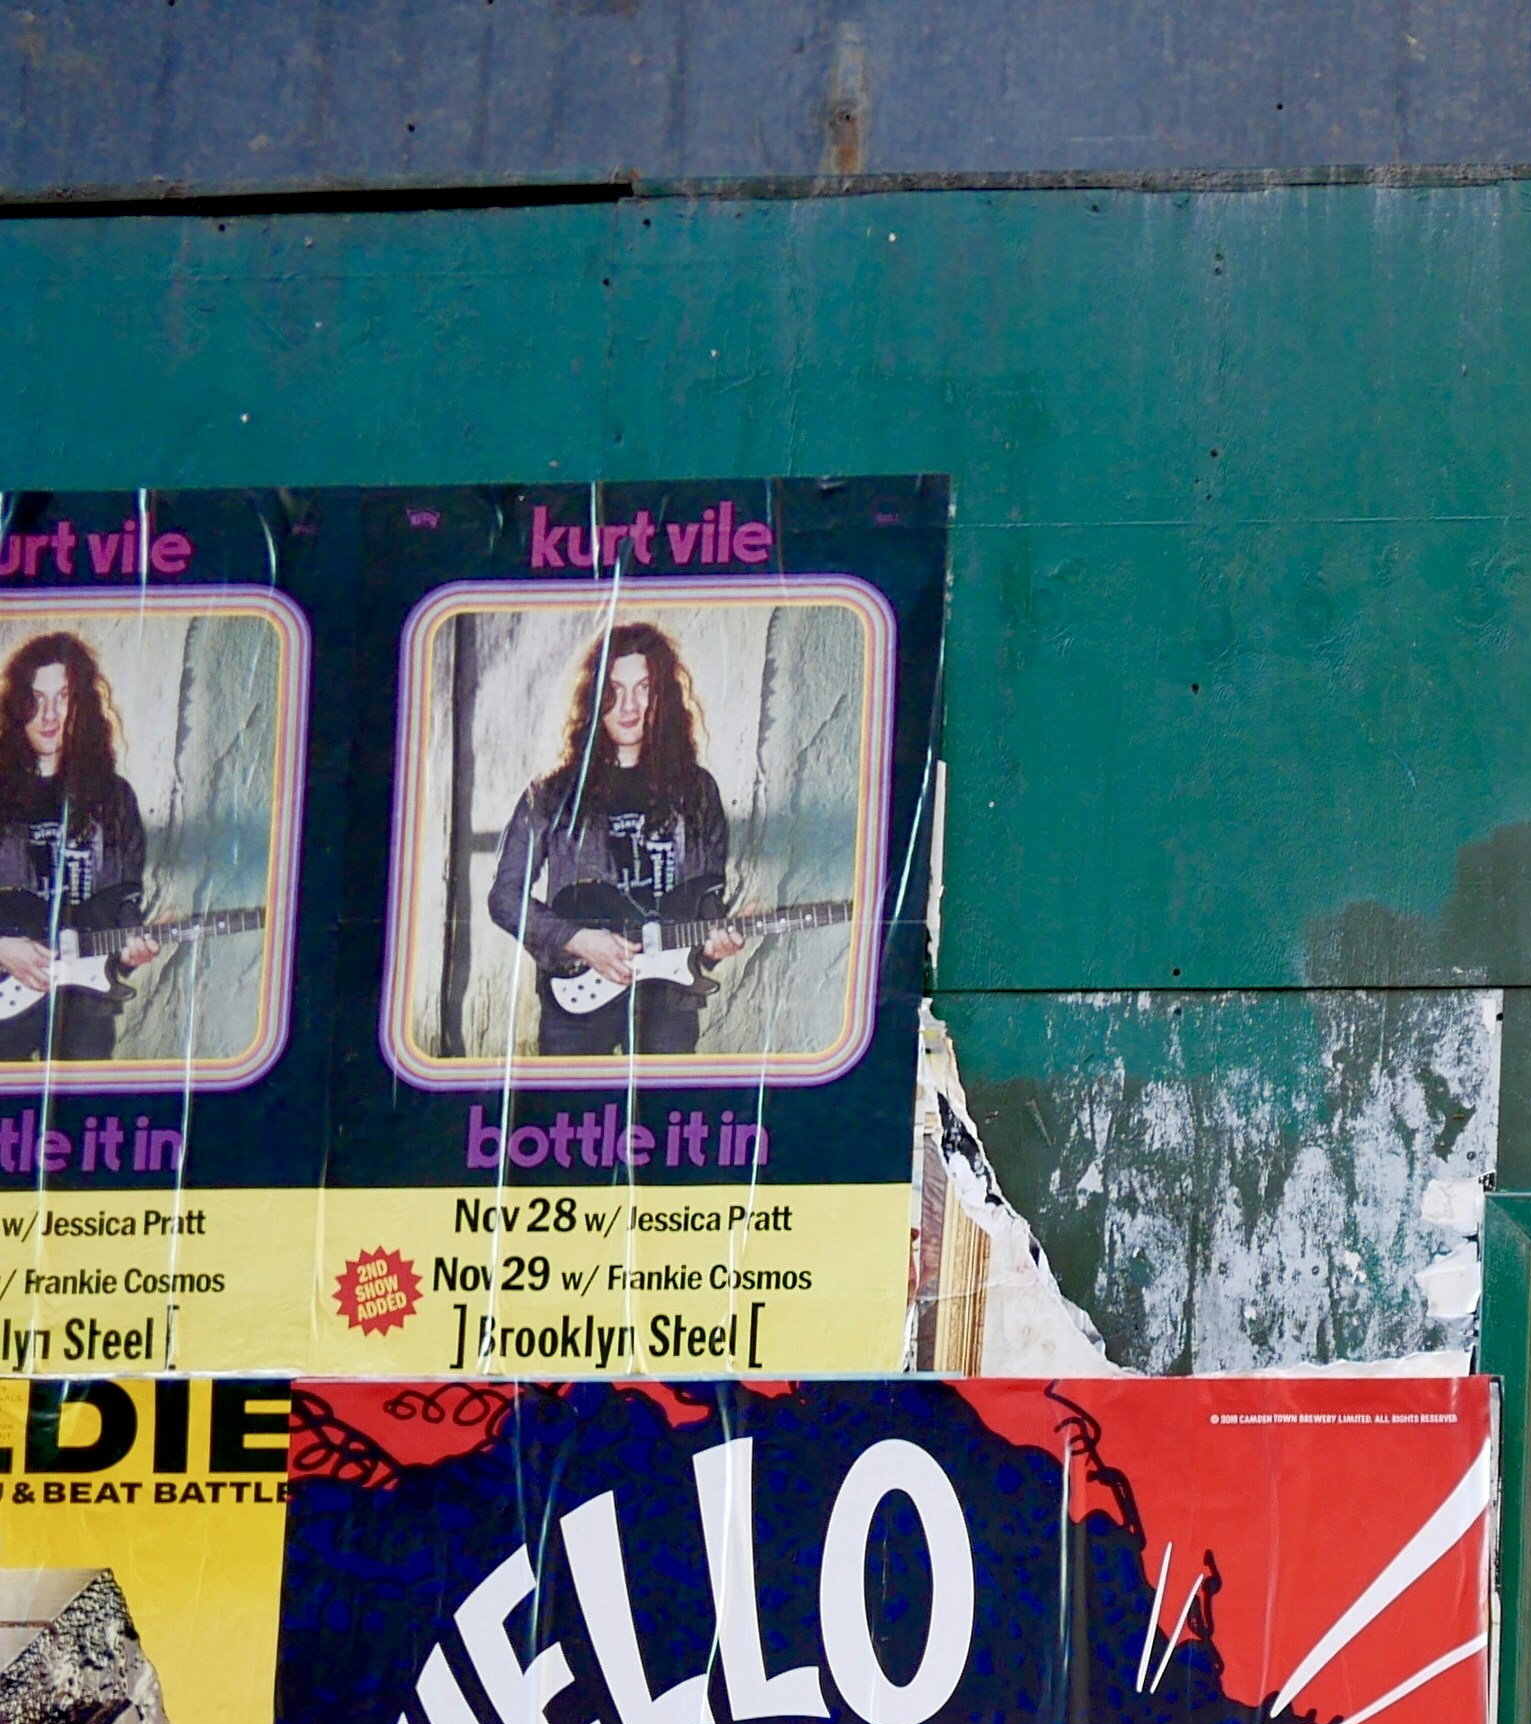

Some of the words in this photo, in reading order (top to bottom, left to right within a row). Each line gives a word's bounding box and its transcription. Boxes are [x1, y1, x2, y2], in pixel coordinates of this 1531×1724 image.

[531, 505, 655, 568] kurt
[666, 500, 773, 565] vile
[82, 1116, 124, 1172] it
[133, 1115, 184, 1171] in
[466, 1104, 655, 1168] bottle
[666, 1110, 708, 1167] it
[718, 1110, 769, 1166] in
[2, 1210, 39, 1243] w/
[41, 1211, 137, 1236] Jessica
[143, 1210, 206, 1235] Pratt
[454, 1198, 520, 1233] Nov
[527, 1198, 577, 1232] 28
[585, 1206, 622, 1238] w/
[628, 1206, 721, 1232] Jessica
[728, 1206, 793, 1231] Pratt
[25, 1269, 117, 1294] Frankie
[124, 1268, 225, 1293] Cosmos
[355, 1274, 398, 1302] SHOW
[357, 1258, 388, 1283] 2ND
[433, 1257, 496, 1291] Nov
[501, 1256, 550, 1290] 29
[562, 1265, 599, 1296] w/
[607, 1264, 702, 1290] Frankie
[709, 1264, 812, 1290] Cosmos
[358, 1291, 407, 1322] ADDED
[64, 1317, 154, 1360] Steel
[478, 1315, 635, 1368] Brooklyn
[649, 1313, 737, 1356] Steel
[0, 1378, 291, 1474] DIE
[1239, 1414, 1273, 1424] CAMDEN
[1273, 1413, 1298, 1423] TOWN
[1299, 1413, 1336, 1423] BREWERY
[1375, 1413, 1390, 1423] ALL
[1392, 1413, 1419, 1423] RIGHTS
[12, 1481, 36, 1505] &
[43, 1482, 143, 1504] BEAT
